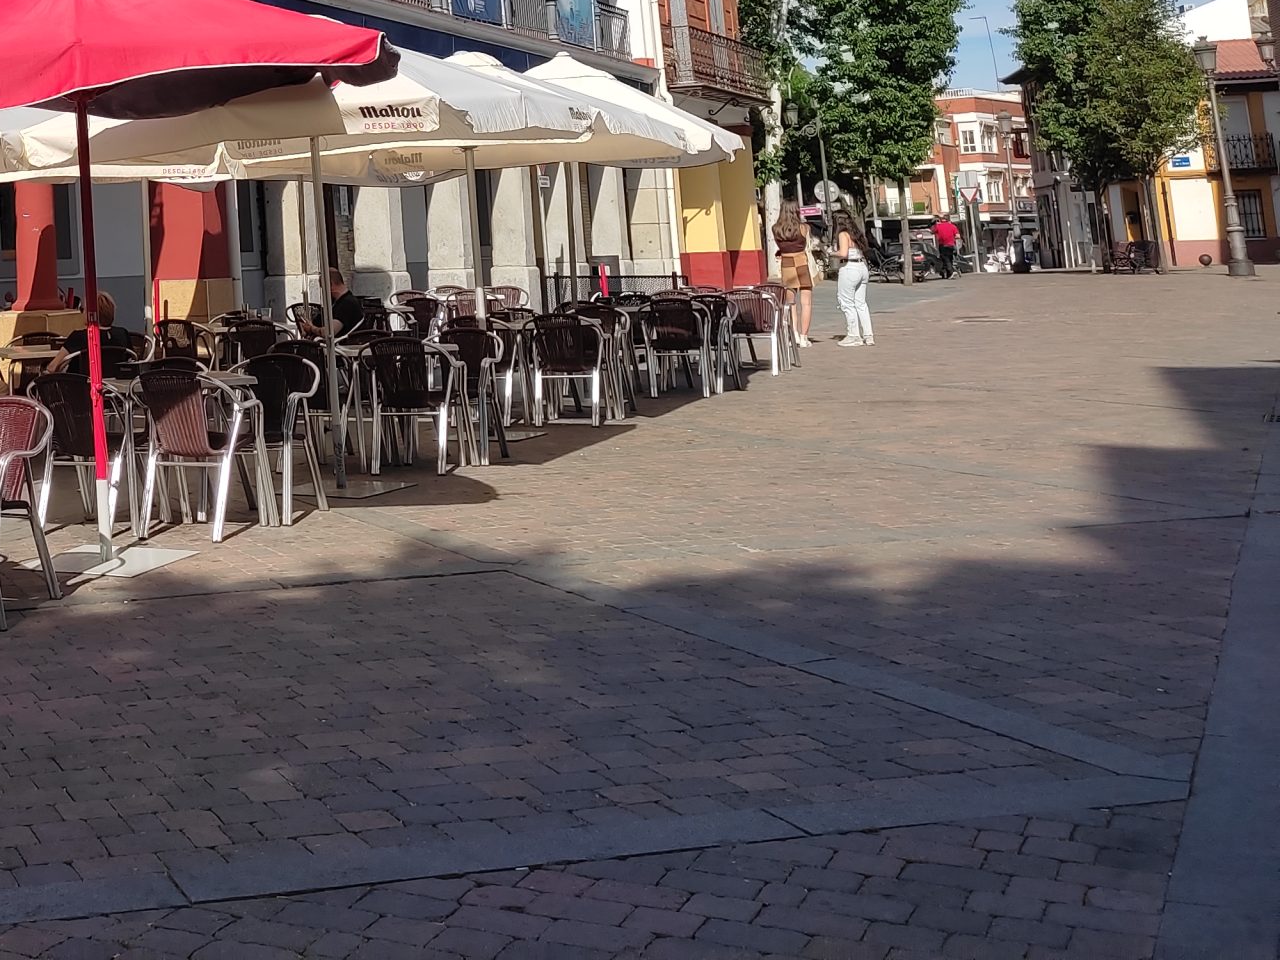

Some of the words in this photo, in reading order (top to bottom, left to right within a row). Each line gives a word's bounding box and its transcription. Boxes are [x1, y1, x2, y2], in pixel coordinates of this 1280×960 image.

[359, 104, 423, 118] Mahou
[364, 122, 397, 130] DESDE
[401, 121, 425, 129] 1890
